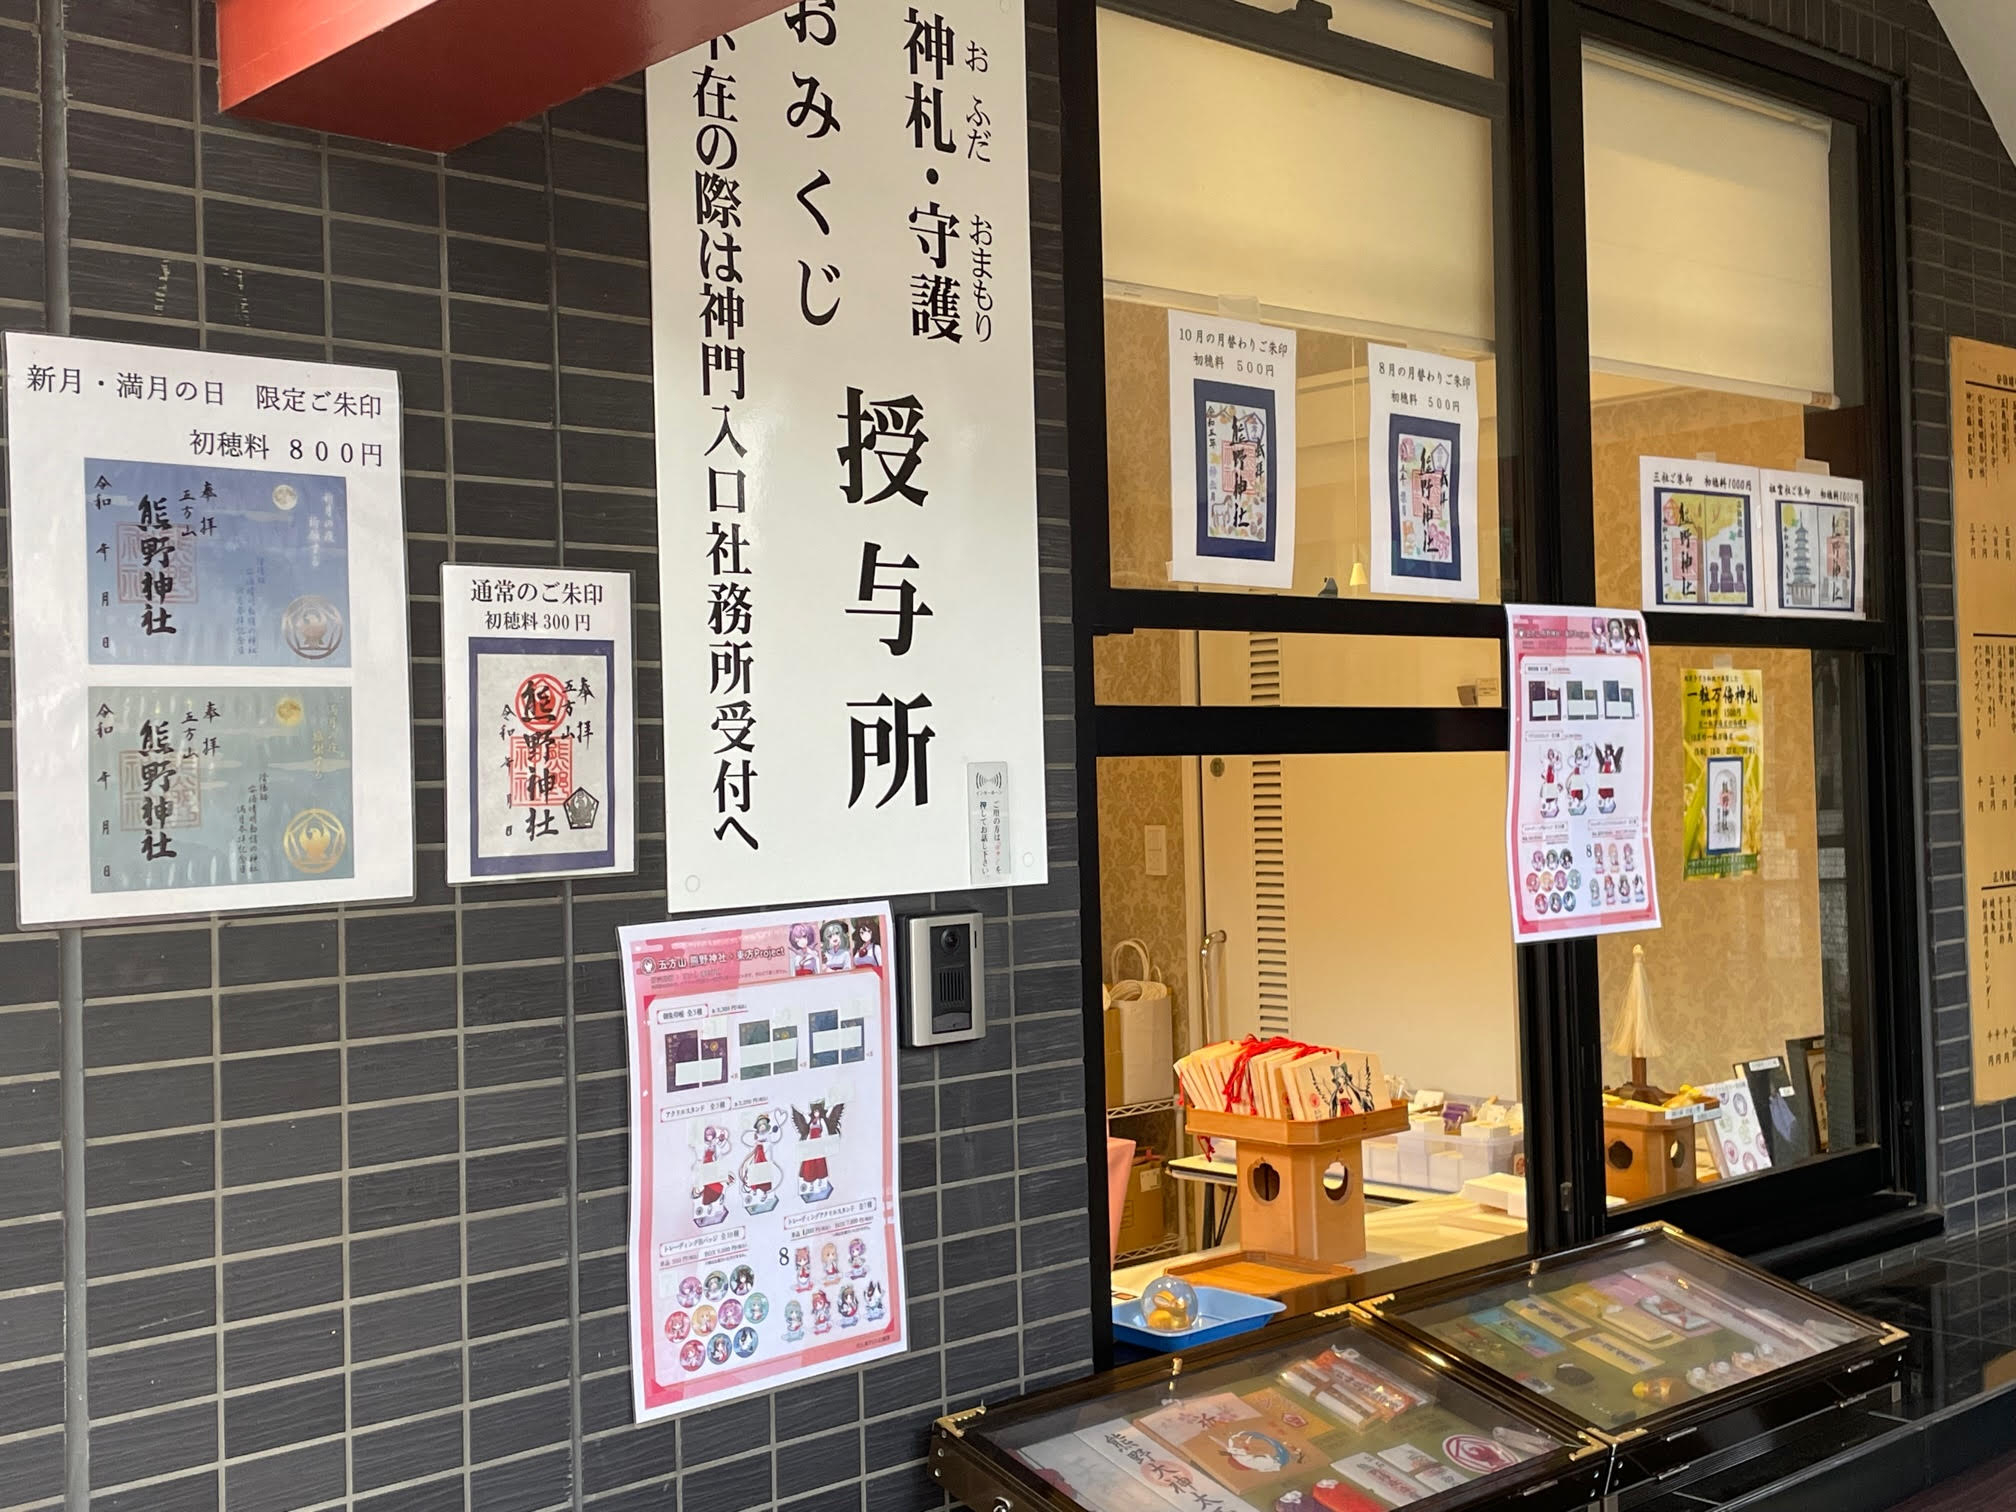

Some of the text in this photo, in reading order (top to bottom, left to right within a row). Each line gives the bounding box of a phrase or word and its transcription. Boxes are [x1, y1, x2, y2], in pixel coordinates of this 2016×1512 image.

[784, 0, 841, 326] おみくじ
[903, 7, 963, 344] 神札・守護
[970, 214, 993, 343] おまもり
[1179, 327, 1288, 358] 10月の月替わりご朱印
[1193, 352, 1275, 378] 初穂料 500円
[1378, 361, 1471, 389] 8月の月替わりご朱印
[27, 363, 382, 419] 新月・満月の日 限定ご朱印
[1391, 389, 1461, 413] 初穂料 500円
[189, 429, 383, 468] 初穂料 800円
[1230, 415, 1250, 528] 熊野神社
[1653, 471, 1693, 485] 三社ご朱印
[94, 475, 112, 508] 令和
[1419, 447, 1440, 553] 熊野神社
[136, 494, 178, 636] 熊野神社
[470, 579, 604, 606] 通常のご朱印
[836, 386, 936, 808] 授与所
[484, 611, 591, 632] 初穂料 300円
[1686, 684, 1758, 705] 一粒万倍神札
[96, 703, 114, 738] 令和
[499, 704, 516, 741] 令和
[520, 679, 560, 842] 熊野神社
[139, 719, 178, 861] 熊野神社
[657, 945, 786, 970] 五方山 熊野神社 東方Project
[665, 1105, 706, 1118] アクリルスタンド
[779, 1247, 790, 1266] 8
